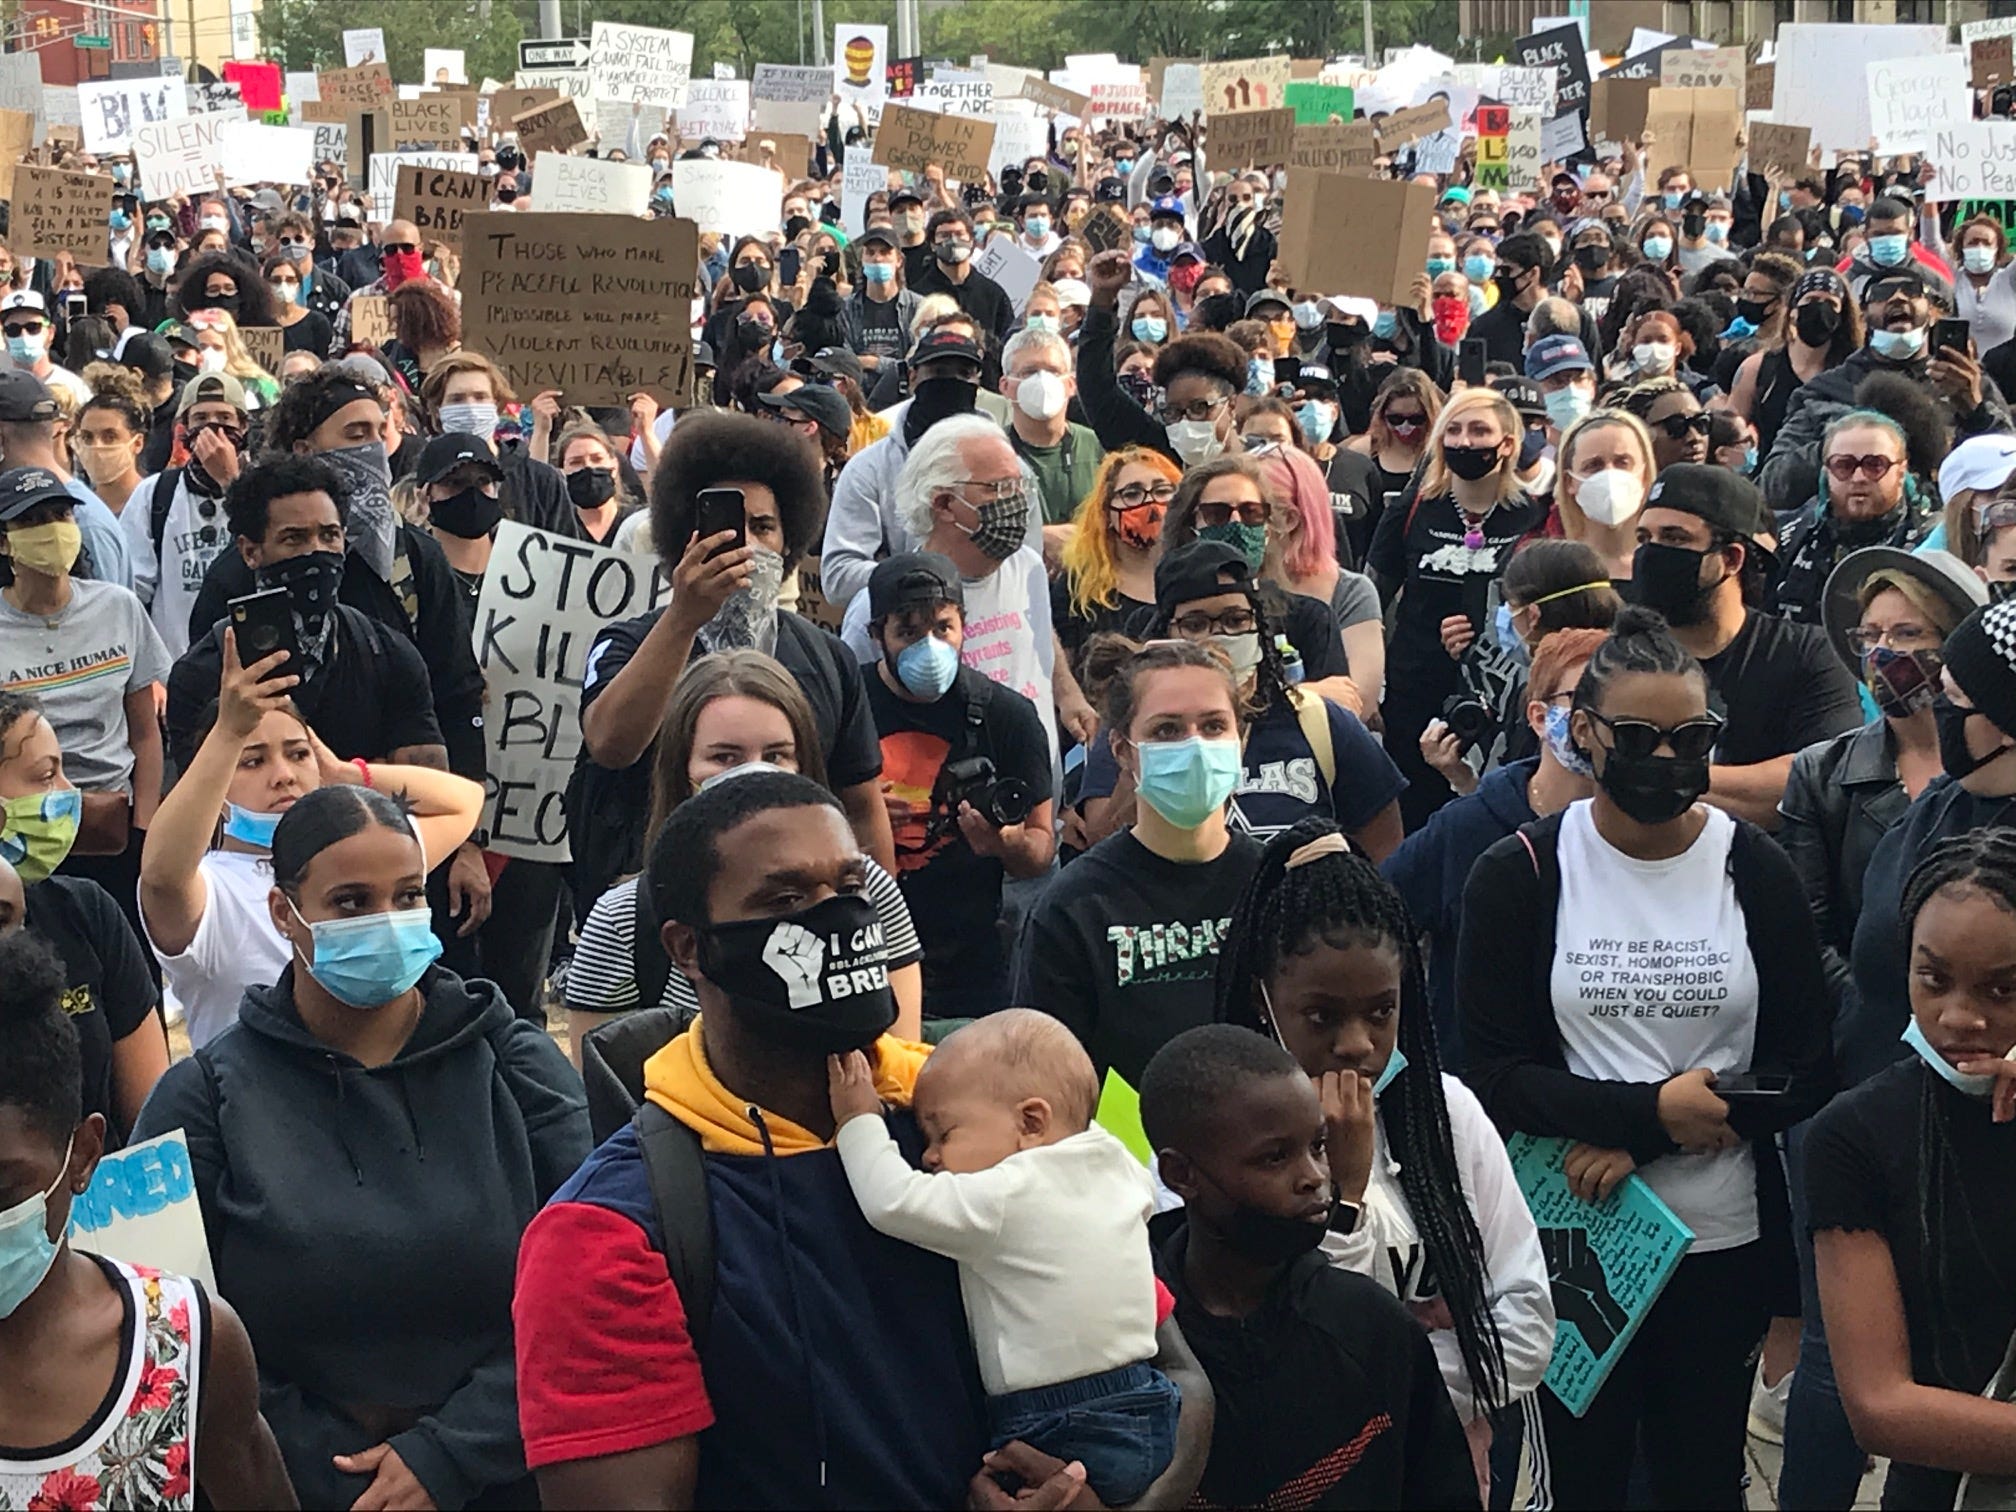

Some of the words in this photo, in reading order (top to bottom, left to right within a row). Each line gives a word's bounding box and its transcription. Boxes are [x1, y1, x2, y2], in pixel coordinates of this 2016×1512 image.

[597, 28, 610, 48] A
[615, 30, 671, 56] SYSTEM
[528, 51, 548, 60] ONE
[553, 50, 573, 60] WAY
[636, 54, 665, 71] FAIL
[1522, 41, 1568, 67] BLACK
[567, 76, 590, 98] YOU
[1500, 68, 1545, 87] BLACK
[1874, 67, 1950, 100] George
[918, 83, 993, 98] TOGETHER
[1497, 86, 1548, 102] LIVES
[393, 101, 452, 119] BLACK
[395, 121, 450, 134] LIVES
[895, 108, 940, 133] REST
[954, 122, 975, 139] IN
[138, 117, 240, 158] SILENC
[314, 127, 347, 146] BLA
[907, 131, 967, 160] POWER
[1937, 131, 1969, 160] No
[315, 147, 347, 162] LIVE
[414, 172, 423, 195] I
[559, 163, 606, 184] BLACK
[1938, 167, 1970, 193] No
[1980, 161, 2016, 192] Pea
[556, 184, 608, 203] LIVES
[415, 205, 463, 230] BRE
[488, 233, 567, 261] THOSE
[577, 246, 616, 259] WHO
[978, 248, 1002, 275] GHT
[480, 270, 580, 295] PEACEFUL
[488, 305, 572, 324] IMPOSSIBLE
[485, 334, 580, 356] VIOLENT
[509, 355, 688, 395] NEVITABLE!
[963, 611, 1022, 639] esisting
[481, 608, 583, 687] KIL
[9, 669, 21, 682] A
[25, 662, 66, 679] NICE
[70, 643, 127, 670] HUMAN
[1237, 757, 1318, 804] LAS
[831, 933, 840, 956] I
[1588, 938, 1622, 951] WHY
[1628, 941, 1648, 953] BE
[1653, 939, 1711, 952] RACIST,
[1565, 952, 1622, 968] SEXIST,
[1628, 952, 1730, 969] HOMOPHOBC
[1581, 971, 1603, 983] OR
[1612, 970, 1723, 986] TRANSPHOBIC
[1579, 987, 1627, 1000] WHEN
[1633, 989, 1666, 1001] YOU
[1673, 987, 1728, 1001] COULD
[1588, 1005, 1629, 1017] JUST
[1634, 1006, 1655, 1018] BE
[1662, 1006, 1720, 1018] QUIET?
